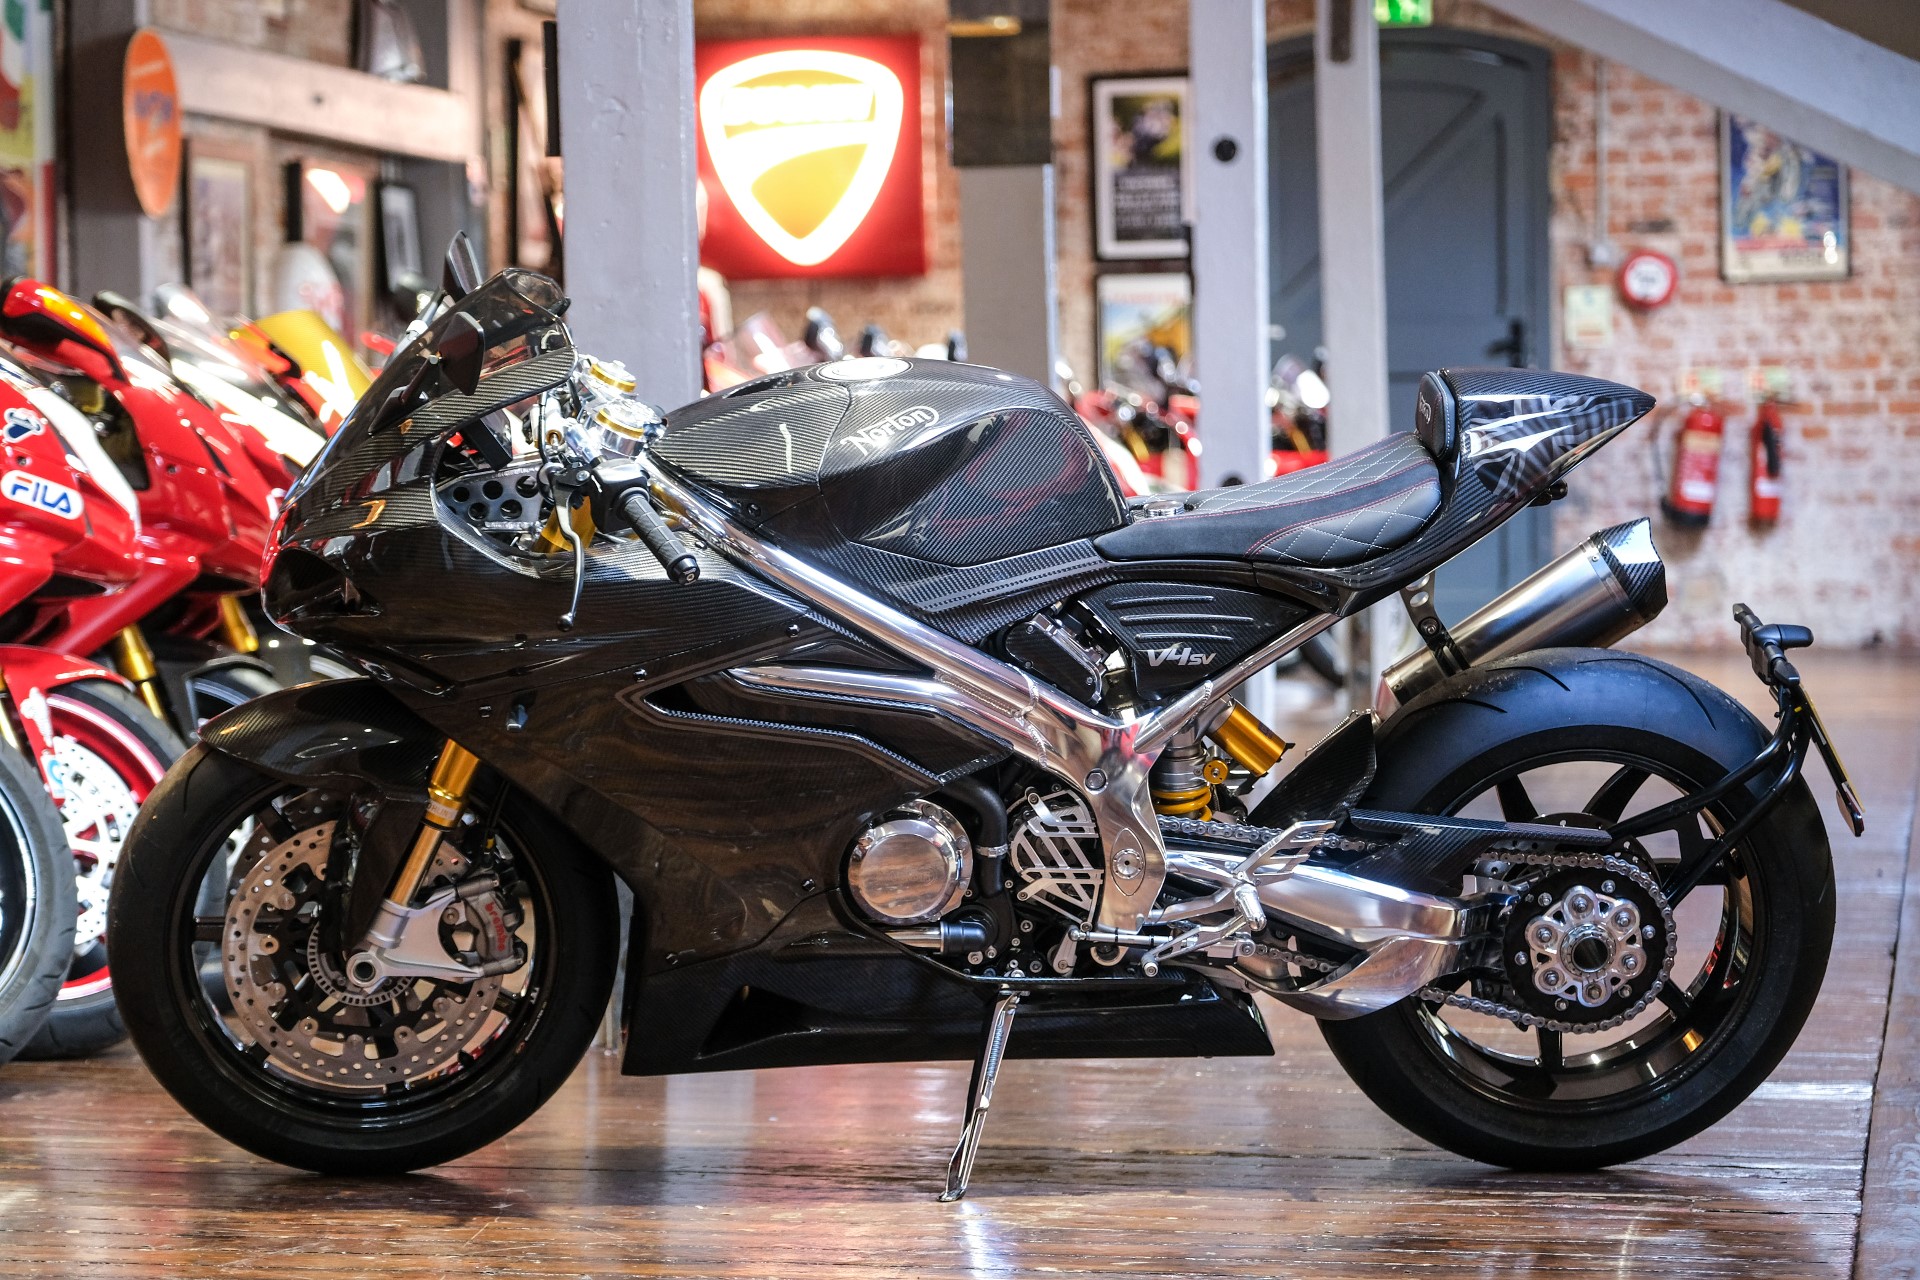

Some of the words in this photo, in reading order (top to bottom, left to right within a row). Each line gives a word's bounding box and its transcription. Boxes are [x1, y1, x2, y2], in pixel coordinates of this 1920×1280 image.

[840, 405, 939, 456] Norton
[11, 476, 71, 513] FILA
[484, 902, 508, 951] brembo
